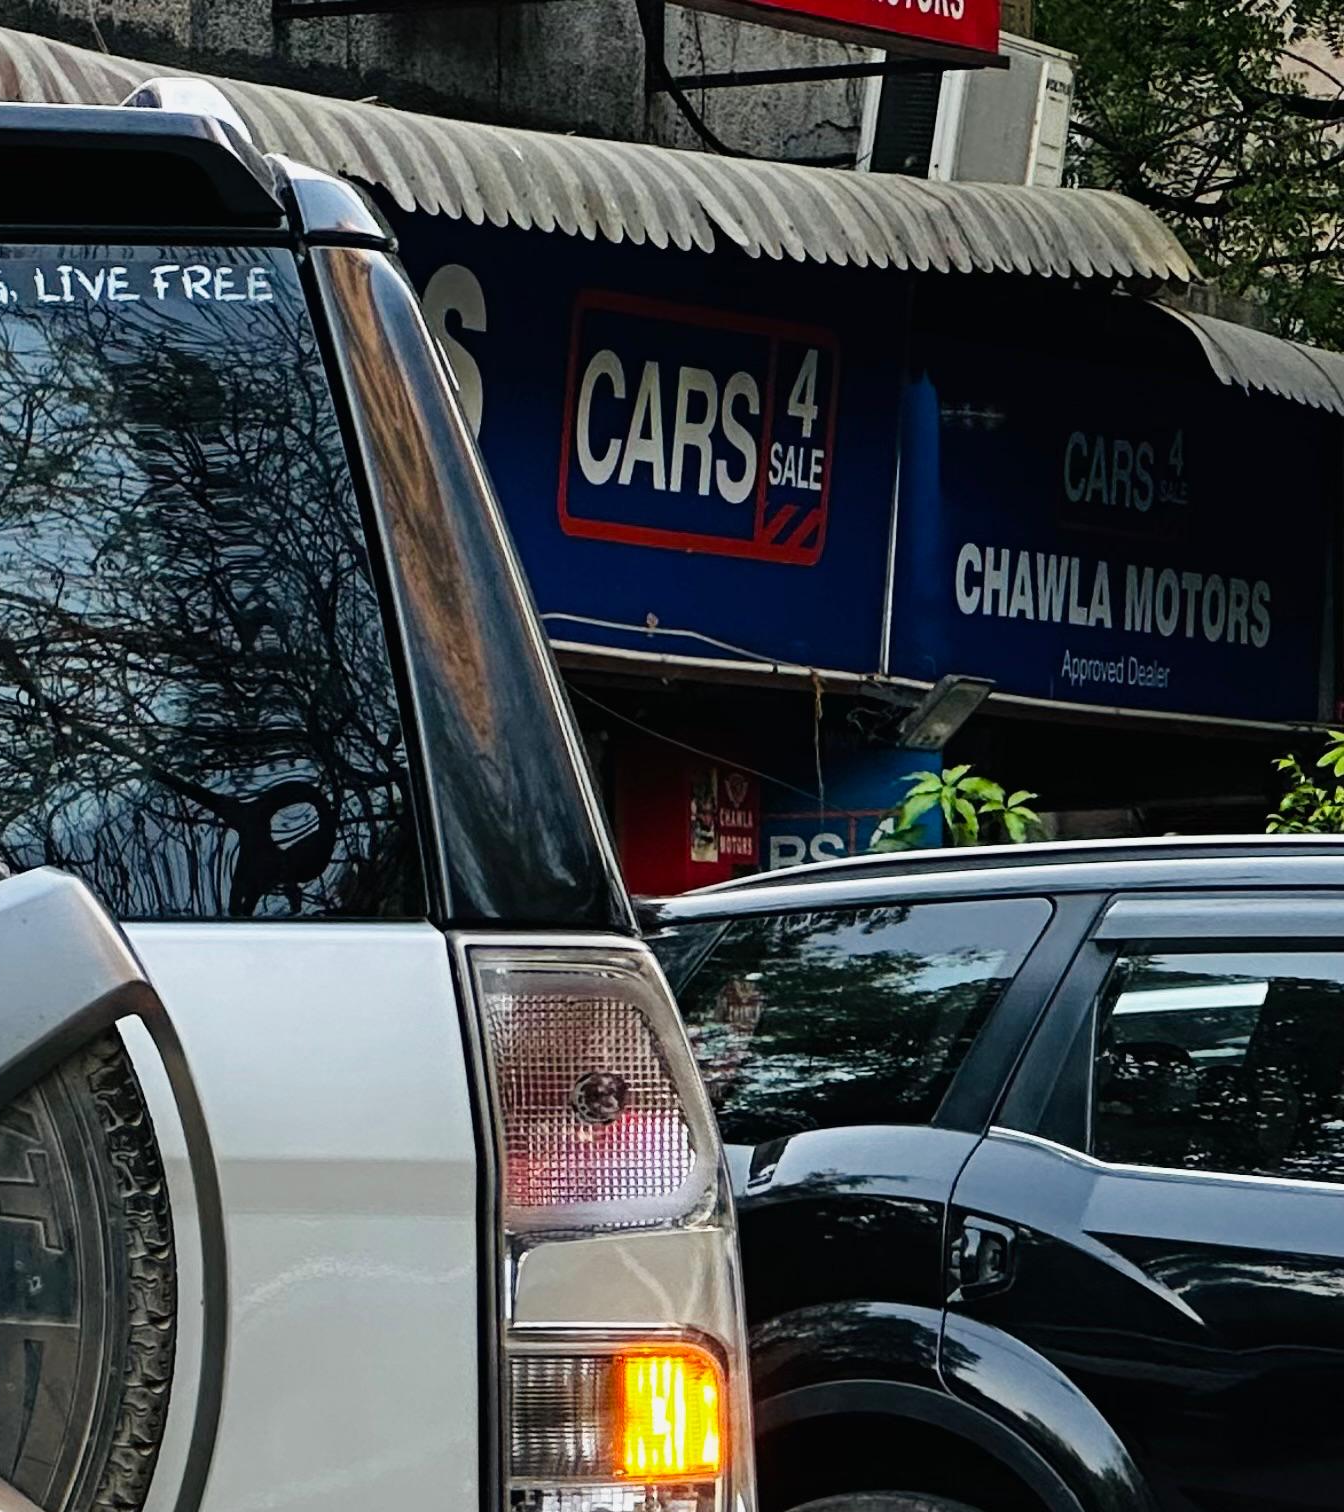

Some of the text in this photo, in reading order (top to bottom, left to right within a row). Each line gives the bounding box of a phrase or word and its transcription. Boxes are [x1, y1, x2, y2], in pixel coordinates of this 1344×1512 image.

[33, 265, 139, 303] LIVE
[150, 265, 275, 302] FREE
[576, 348, 761, 506] CARS
[786, 348, 820, 440] 4
[768, 442, 826, 492] SALE
[1064, 431, 1154, 512] CARS
[955, 542, 1271, 648] CHAWLA MOTORS
[1061, 649, 1170, 688] Approved Dealer
[719, 808, 753, 828] CHAWLA
[719, 835, 753, 856] MOTORS
